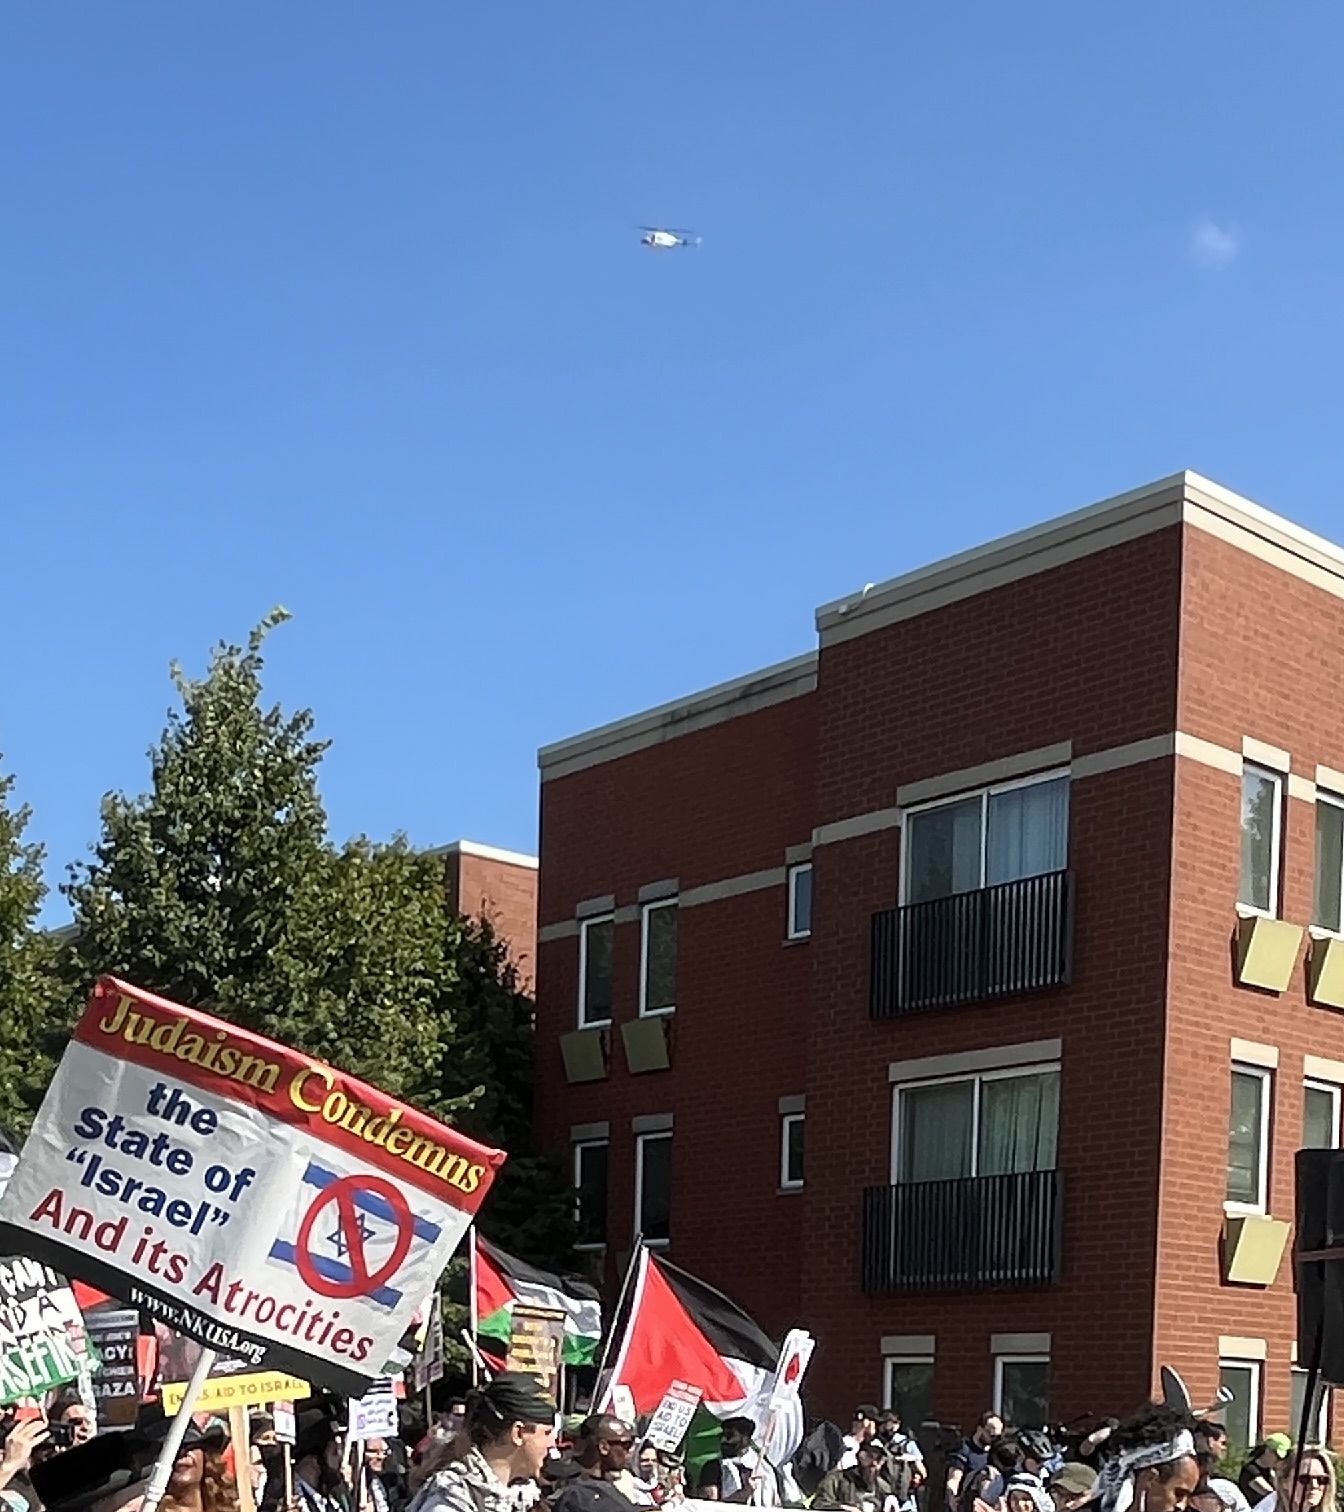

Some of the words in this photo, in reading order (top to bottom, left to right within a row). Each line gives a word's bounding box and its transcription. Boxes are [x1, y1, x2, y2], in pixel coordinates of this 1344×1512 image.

[99, 995, 281, 1094] Judaism
[289, 1066, 486, 1194] Condemns
[146, 1082, 218, 1135] the
[66, 1147, 230, 1236] “Israel”
[205, 1164, 256, 1202] of
[29, 1188, 129, 1254] And
[131, 1226, 188, 1285] its
[192, 1262, 374, 1362] Atrocities
[239, 1383, 257, 1395] TO
